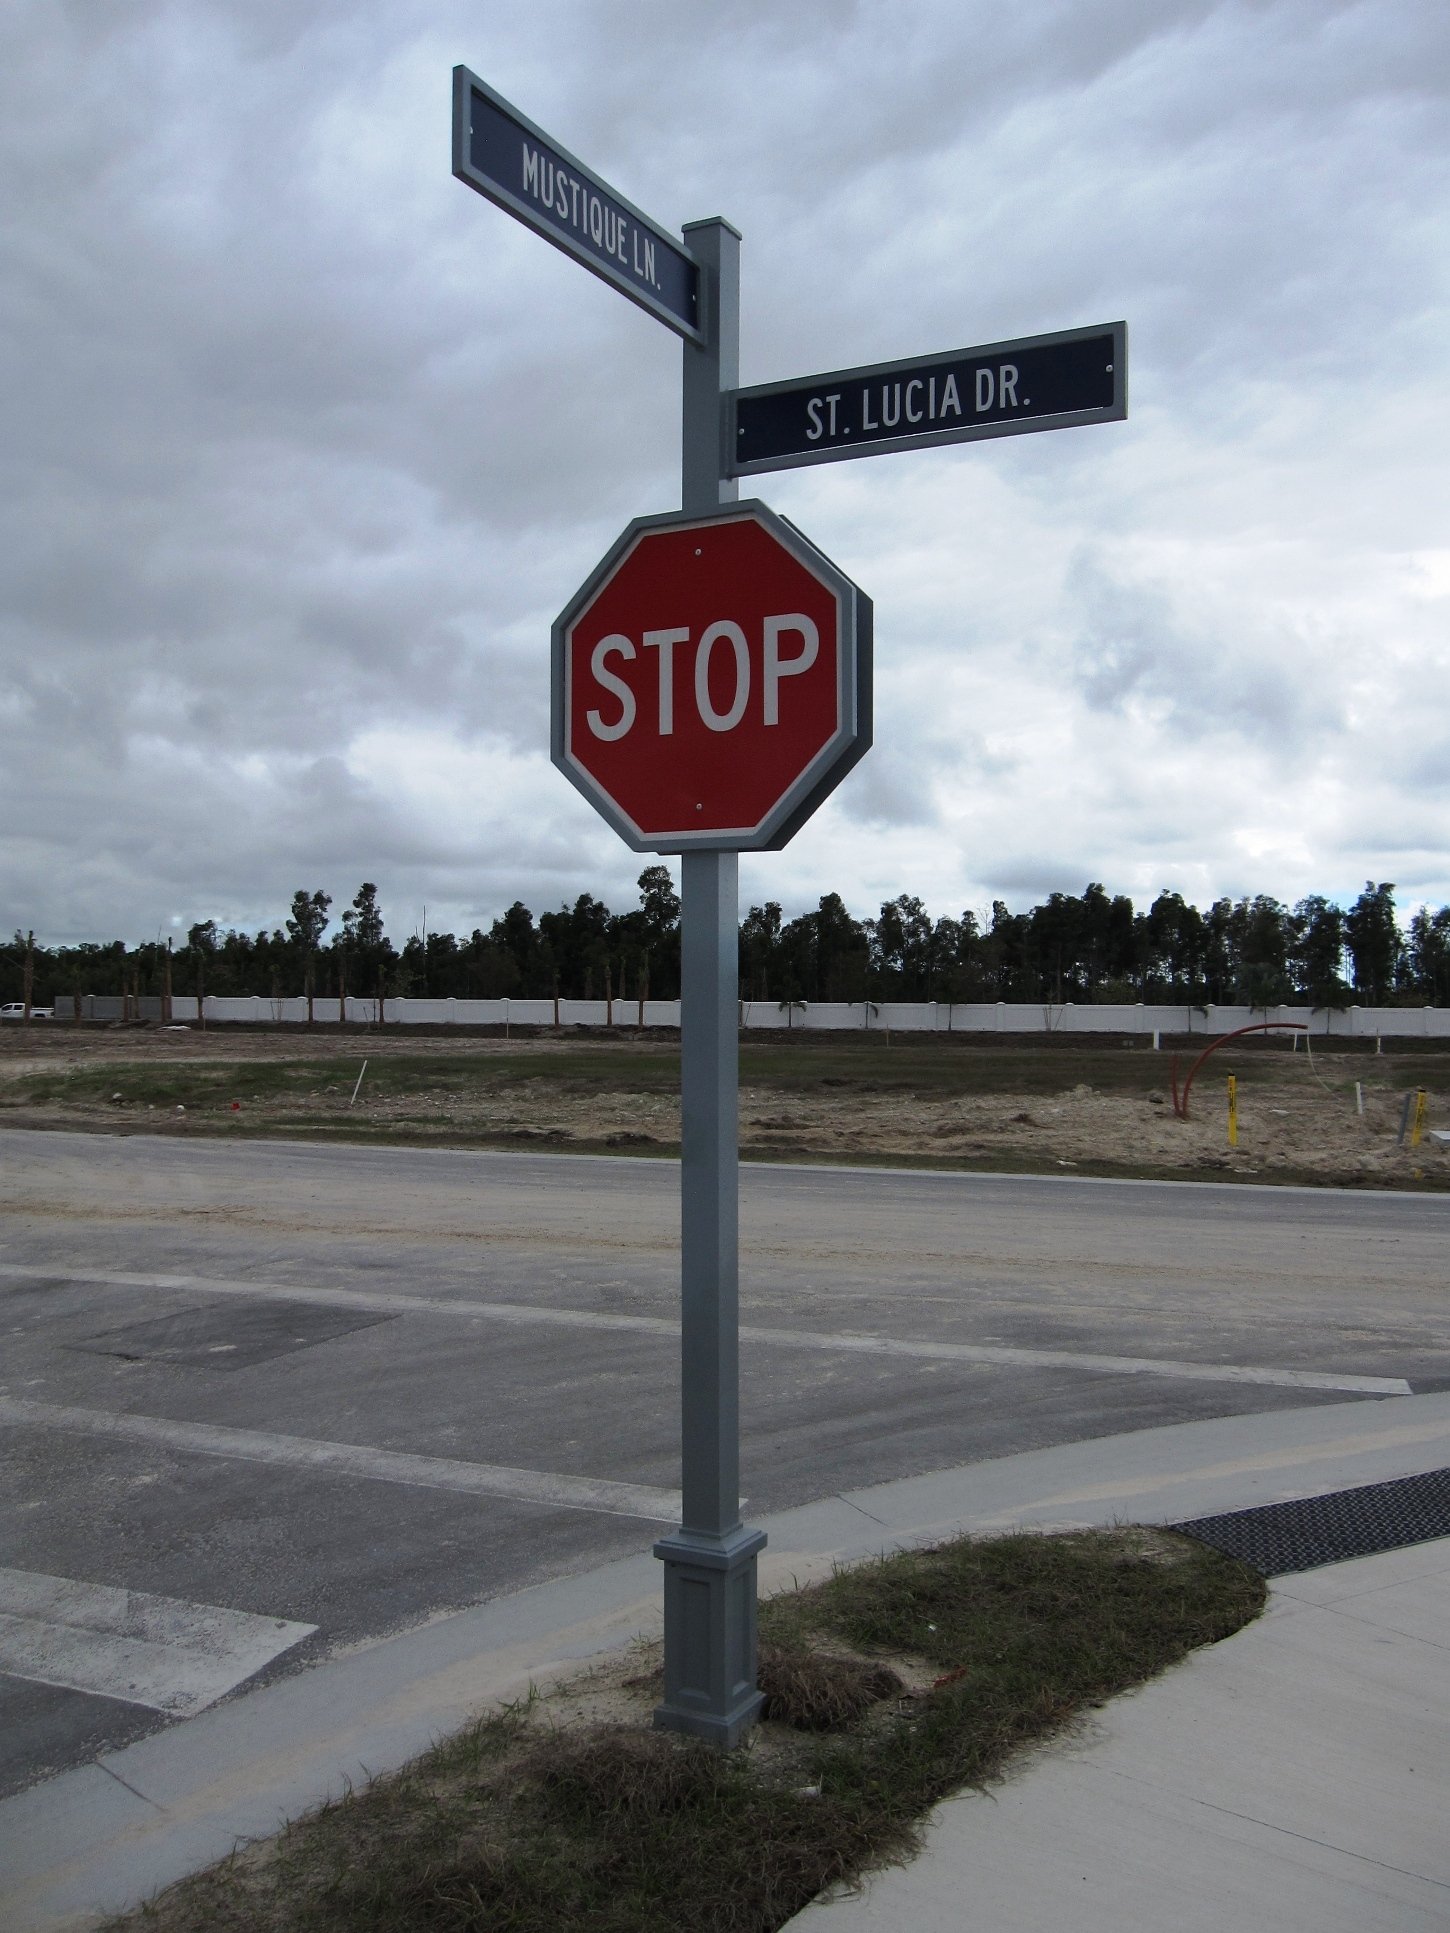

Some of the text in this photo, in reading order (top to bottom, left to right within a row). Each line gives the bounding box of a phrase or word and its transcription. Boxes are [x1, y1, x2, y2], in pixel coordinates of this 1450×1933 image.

[522, 143, 661, 290] MUSTIQUE LN.
[806, 364, 1031, 440] ST. LUCIA DR.
[586, 612, 820, 742] STOP
